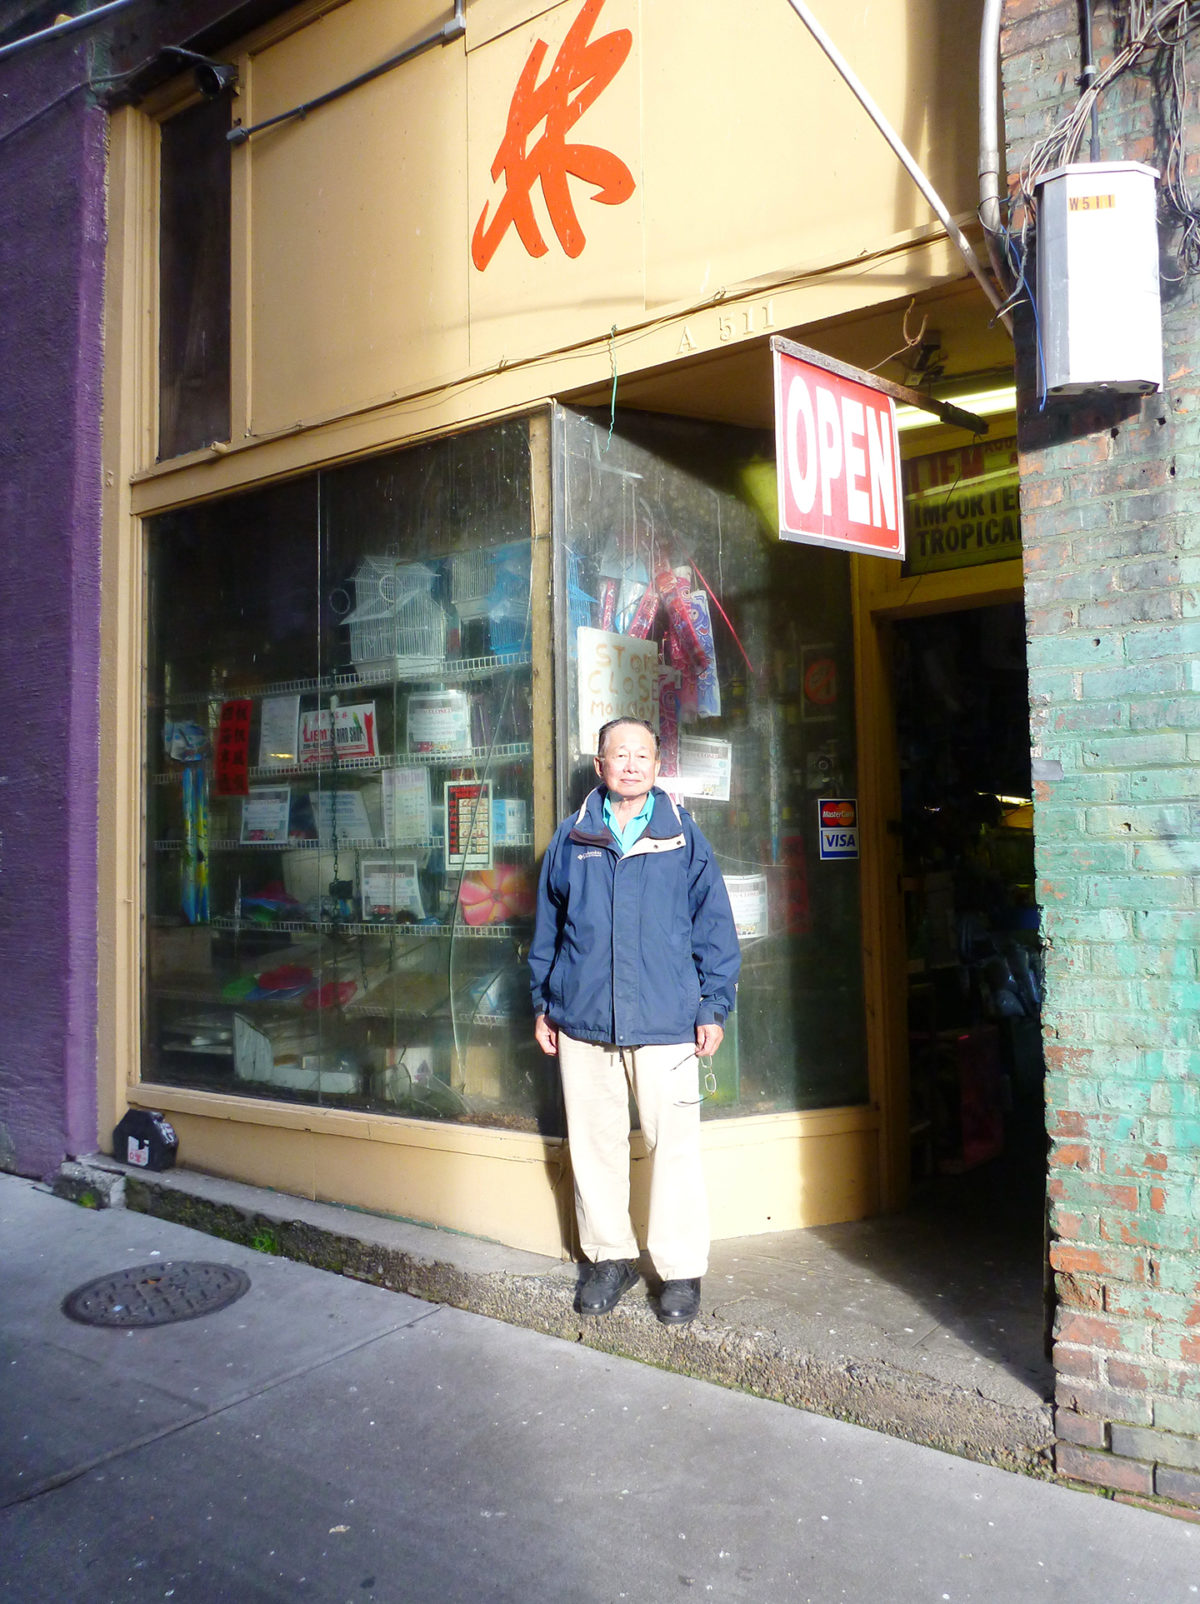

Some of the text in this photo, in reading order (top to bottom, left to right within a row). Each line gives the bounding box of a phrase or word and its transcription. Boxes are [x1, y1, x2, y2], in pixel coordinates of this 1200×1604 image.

[675, 299, 776, 355] A 511
[786, 375, 897, 532] OPEN
[914, 486, 1020, 529] IMPORTE
[588, 670, 659, 702] CLOSE
[825, 834, 856, 847] VISA
